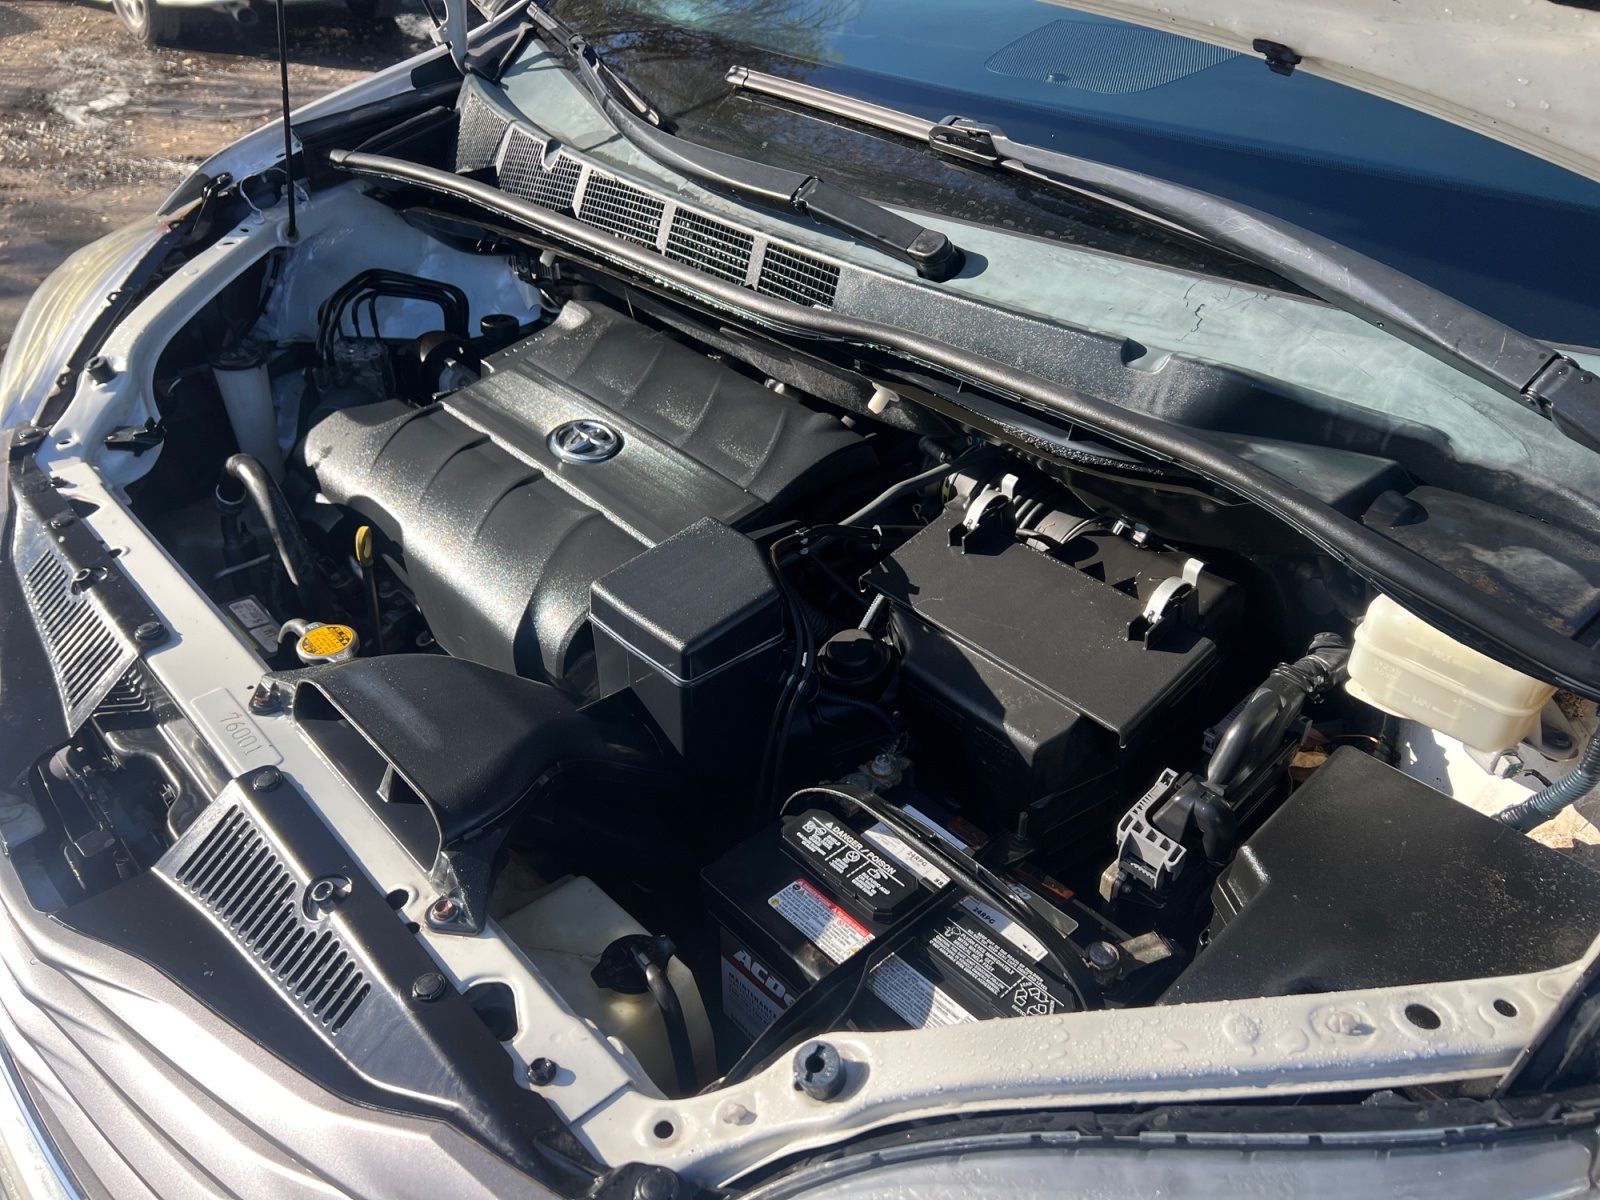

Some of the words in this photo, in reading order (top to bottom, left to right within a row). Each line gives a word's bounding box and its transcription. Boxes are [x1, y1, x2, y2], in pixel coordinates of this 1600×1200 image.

[220, 711, 263, 756] 76001
[832, 825, 863, 850] DANGER
[866, 850, 896, 875] POISON
[906, 850, 927, 866] 24RPG
[972, 904, 995, 926] 24RPG
[952, 939, 973, 955] MEDICAL
[984, 951, 1015, 975] IMMEDIATELY
